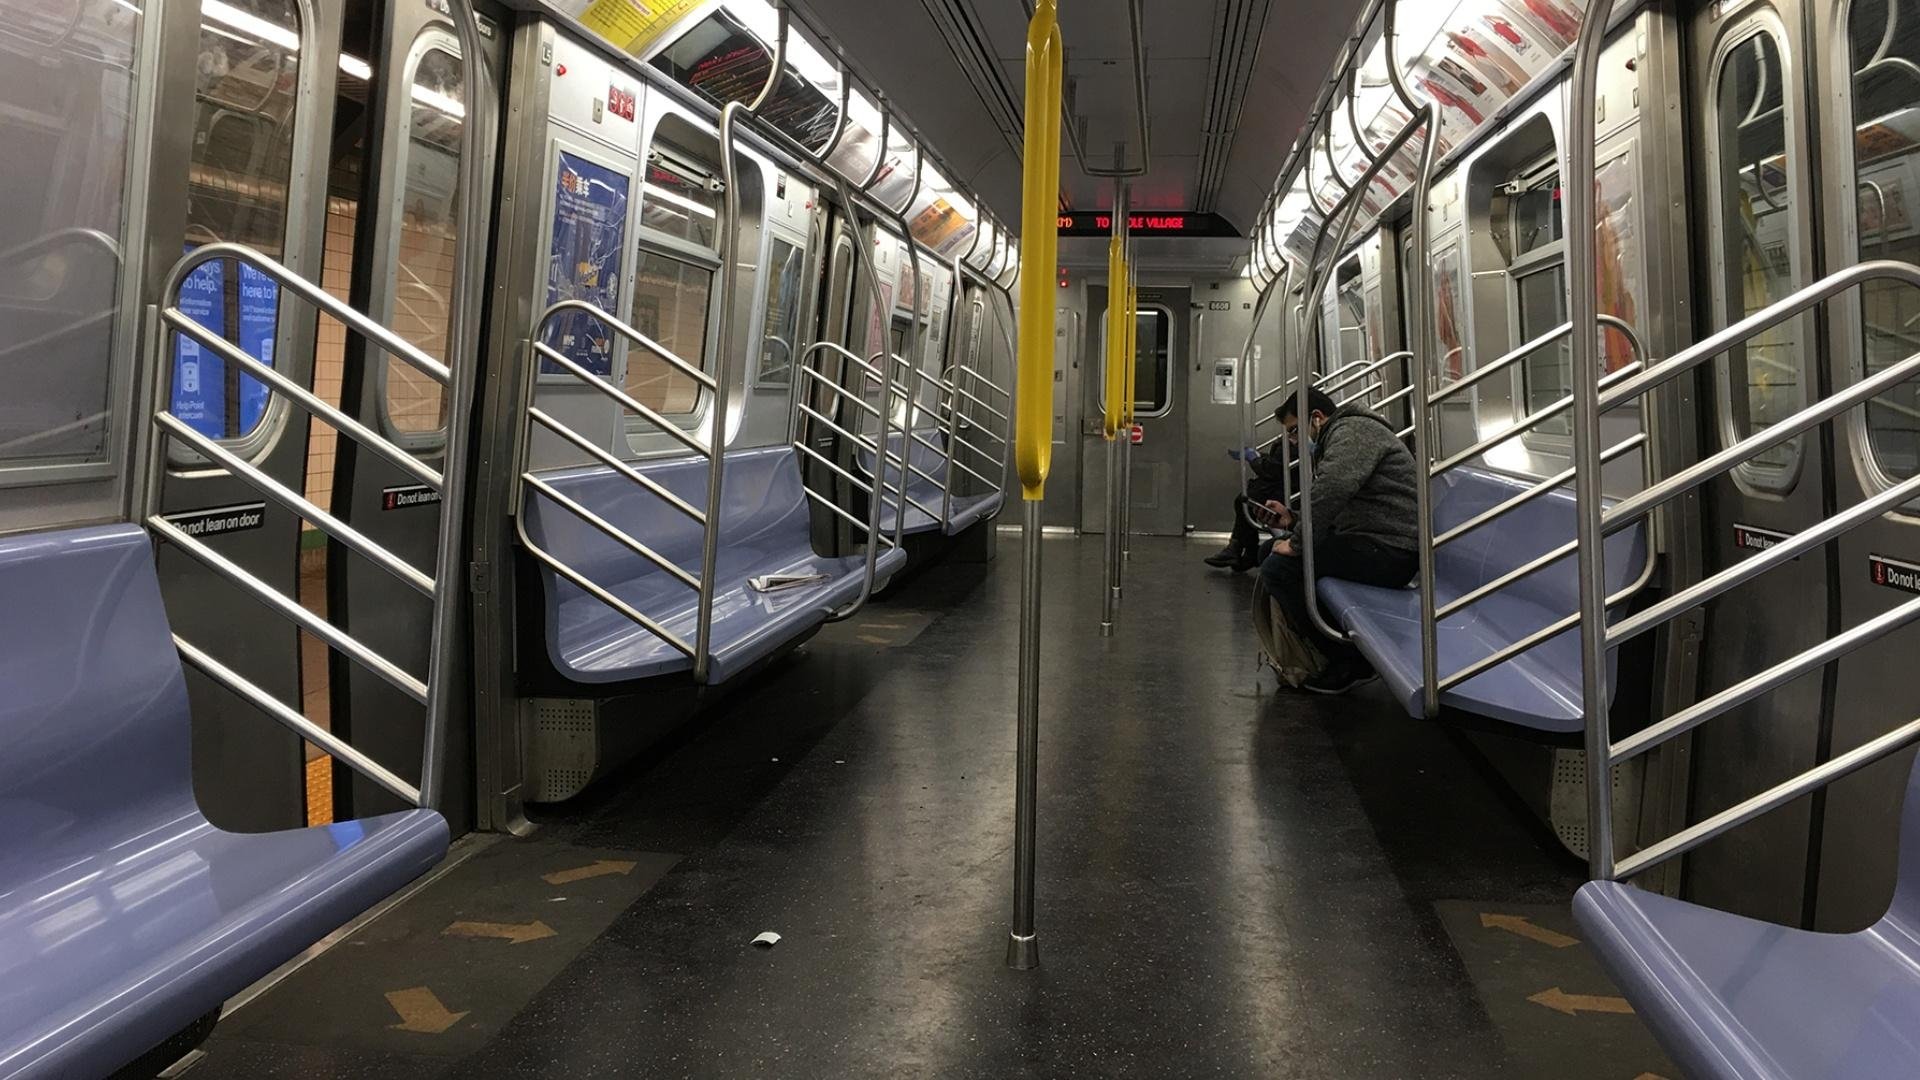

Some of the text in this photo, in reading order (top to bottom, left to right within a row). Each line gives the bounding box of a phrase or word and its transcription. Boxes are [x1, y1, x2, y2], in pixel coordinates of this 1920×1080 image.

[1096, 217, 1109, 228] TO
[1146, 217, 1183, 228] VILLAGE
[195, 275, 217, 294] help.
[242, 283, 262, 298] here
[263, 285, 273, 299] to
[398, 493, 406, 505] Do
[408, 492, 417, 504] not
[418, 491, 431, 502] lean
[188, 519, 204, 534] not
[206, 518, 225, 532] lean
[226, 516, 238, 529] on
[240, 513, 260, 527] door
[1745, 533, 1753, 546] Do
[1753, 536, 1763, 548] not
[1888, 567, 1899, 585] Do
[1900, 573, 1913, 589] not
